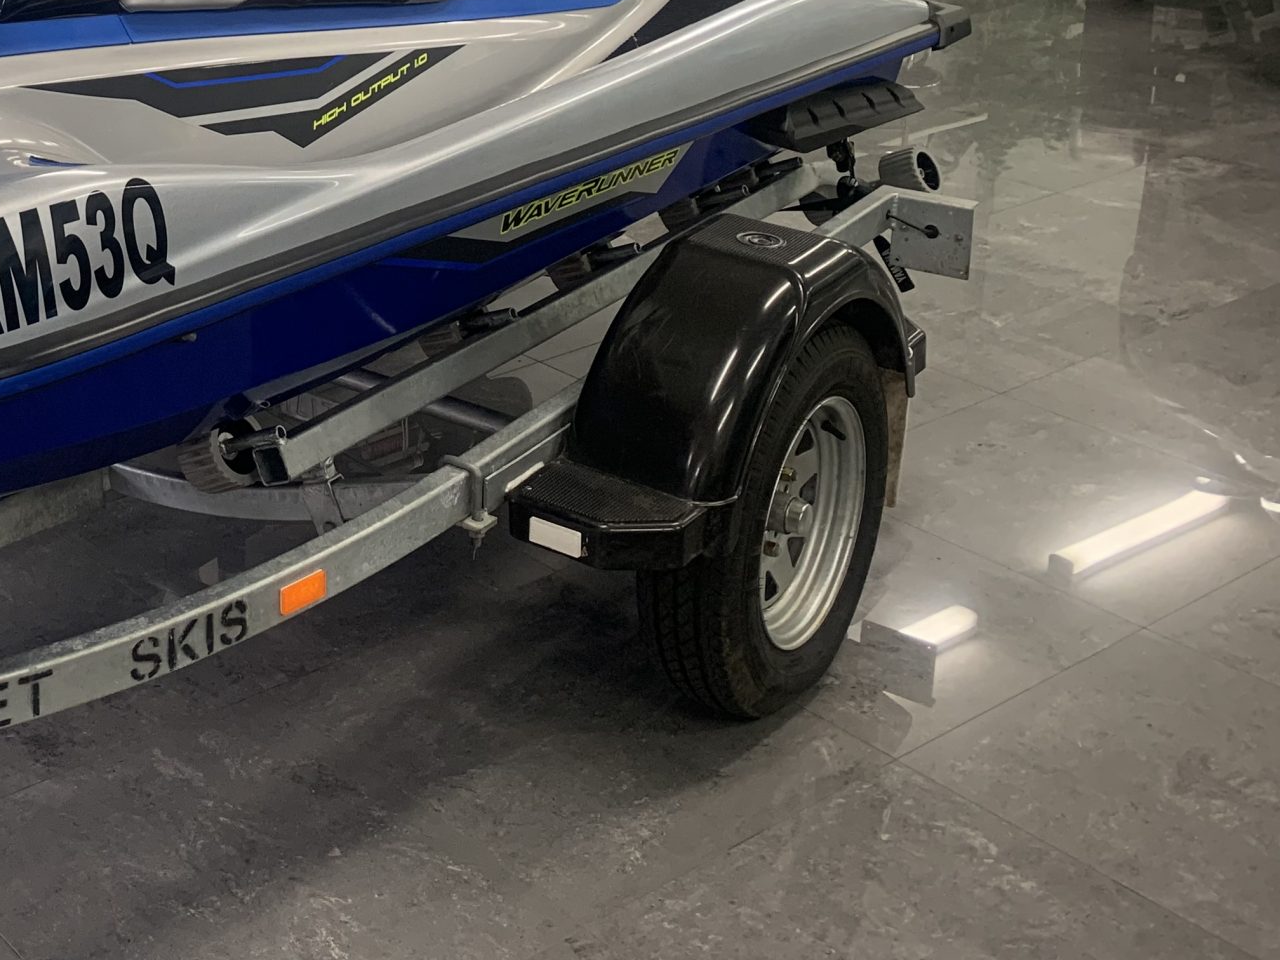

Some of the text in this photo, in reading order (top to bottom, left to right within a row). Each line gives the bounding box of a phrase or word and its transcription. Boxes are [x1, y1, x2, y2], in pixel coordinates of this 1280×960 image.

[313, 102, 346, 130] HIGH
[351, 63, 410, 107] OUTPUT
[500, 147, 680, 235] WAVERUNNER
[130, 599, 248, 682] SKIS
